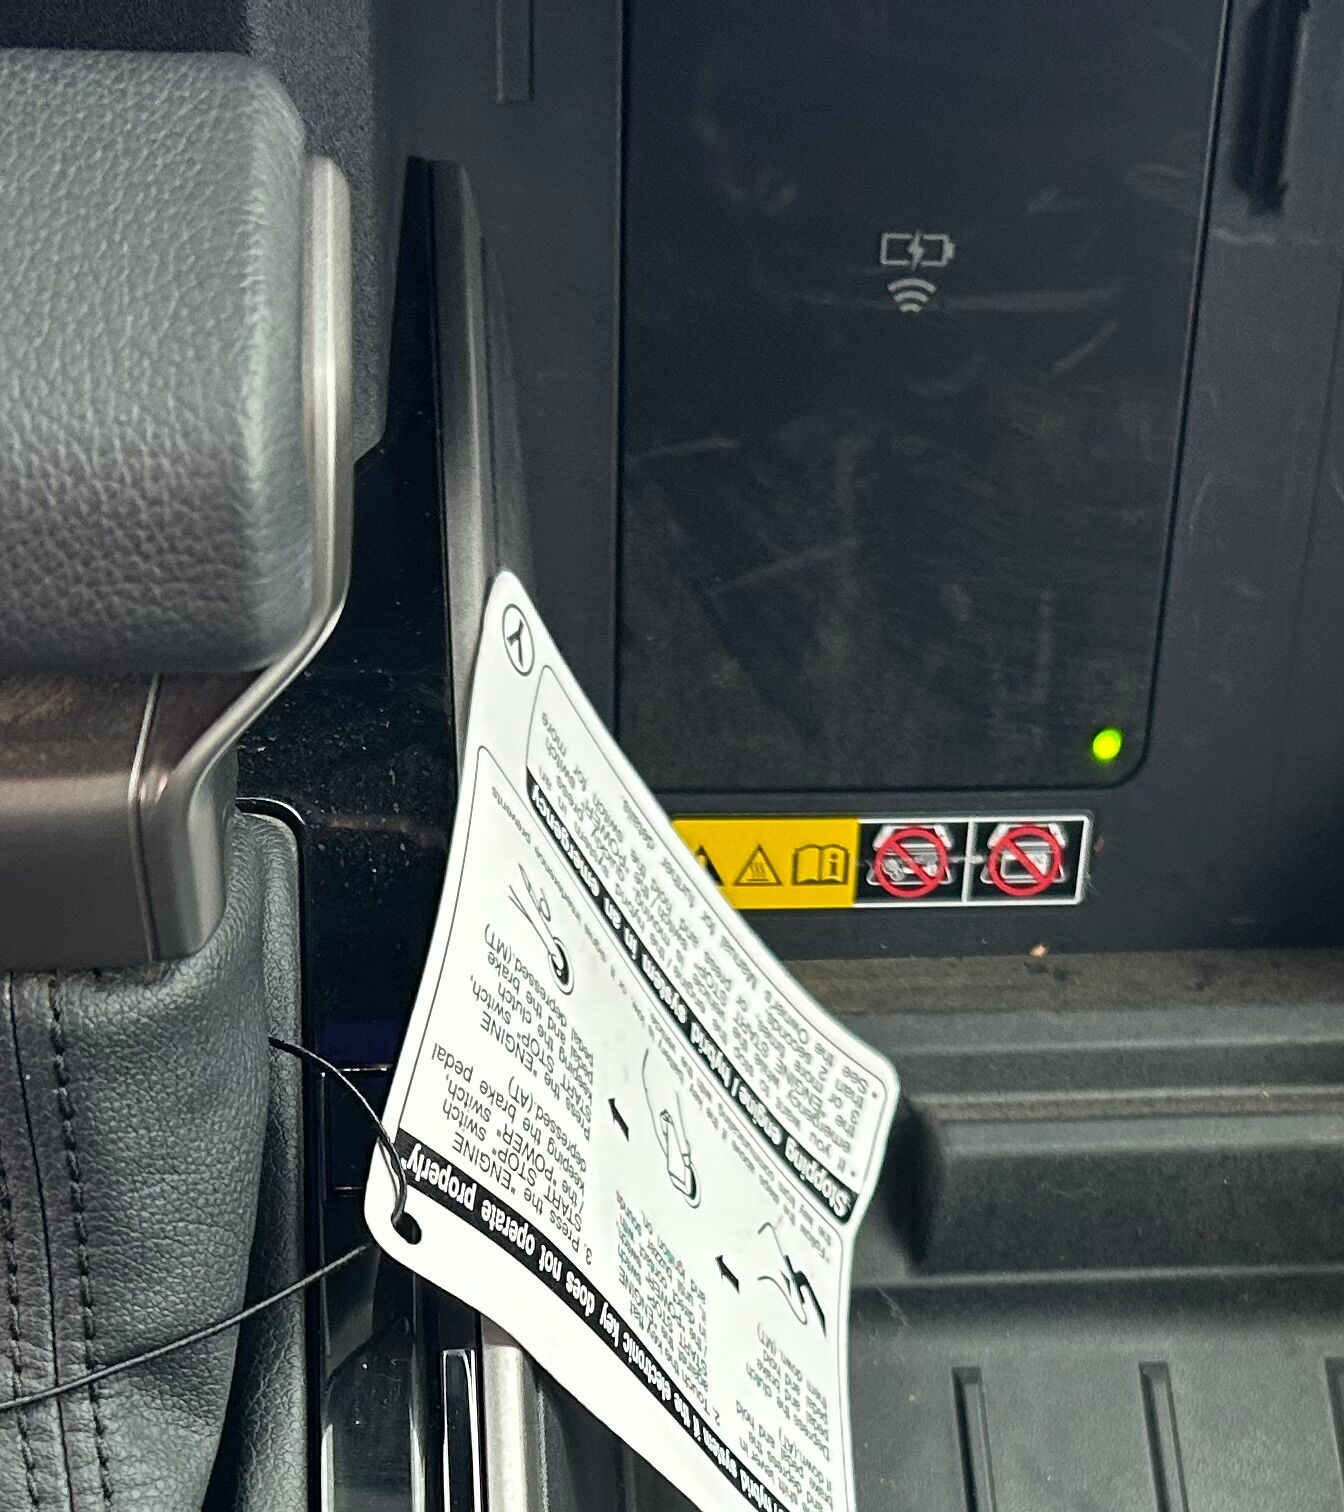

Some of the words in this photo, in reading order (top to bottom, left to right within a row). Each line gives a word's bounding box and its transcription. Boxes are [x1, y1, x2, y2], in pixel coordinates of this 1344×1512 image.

[506, 618, 524, 669] Y
[532, 785, 599, 896] emergency
[604, 898, 621, 929] an
[624, 927, 637, 960] in
[488, 952, 520, 995] brake
[498, 982, 532, 1024] clutch
[526, 991, 542, 1019] the
[480, 1011, 537, 1077] "ENGINE
[517, 1032, 554, 1073] STOP"
[538, 1024, 553, 1052] the
[432, 1043, 473, 1083] pedal
[446, 1074, 491, 1122] switch,
[480, 1080, 516, 1124] brake
[544, 1072, 560, 1100] the
[443, 1099, 486, 1141] switch
[523, 1118, 541, 1145] the
[454, 1132, 515, 1194] "ENGINE
[492, 1148, 537, 1187] STOP"
[497, 1124, 556, 1186] "POWER"
[547, 1137, 584, 1196] keeping
[524, 1188, 543, 1215] the
[785, 1137, 850, 1225] Stopping
[481, 1200, 535, 1255] operate
[543, 1185, 582, 1232] START
[550, 1210, 579, 1253] Press
[539, 1245, 562, 1281] not
[584, 1244, 592, 1265] 3.
[566, 1271, 595, 1316] does
[600, 1302, 619, 1347] key
